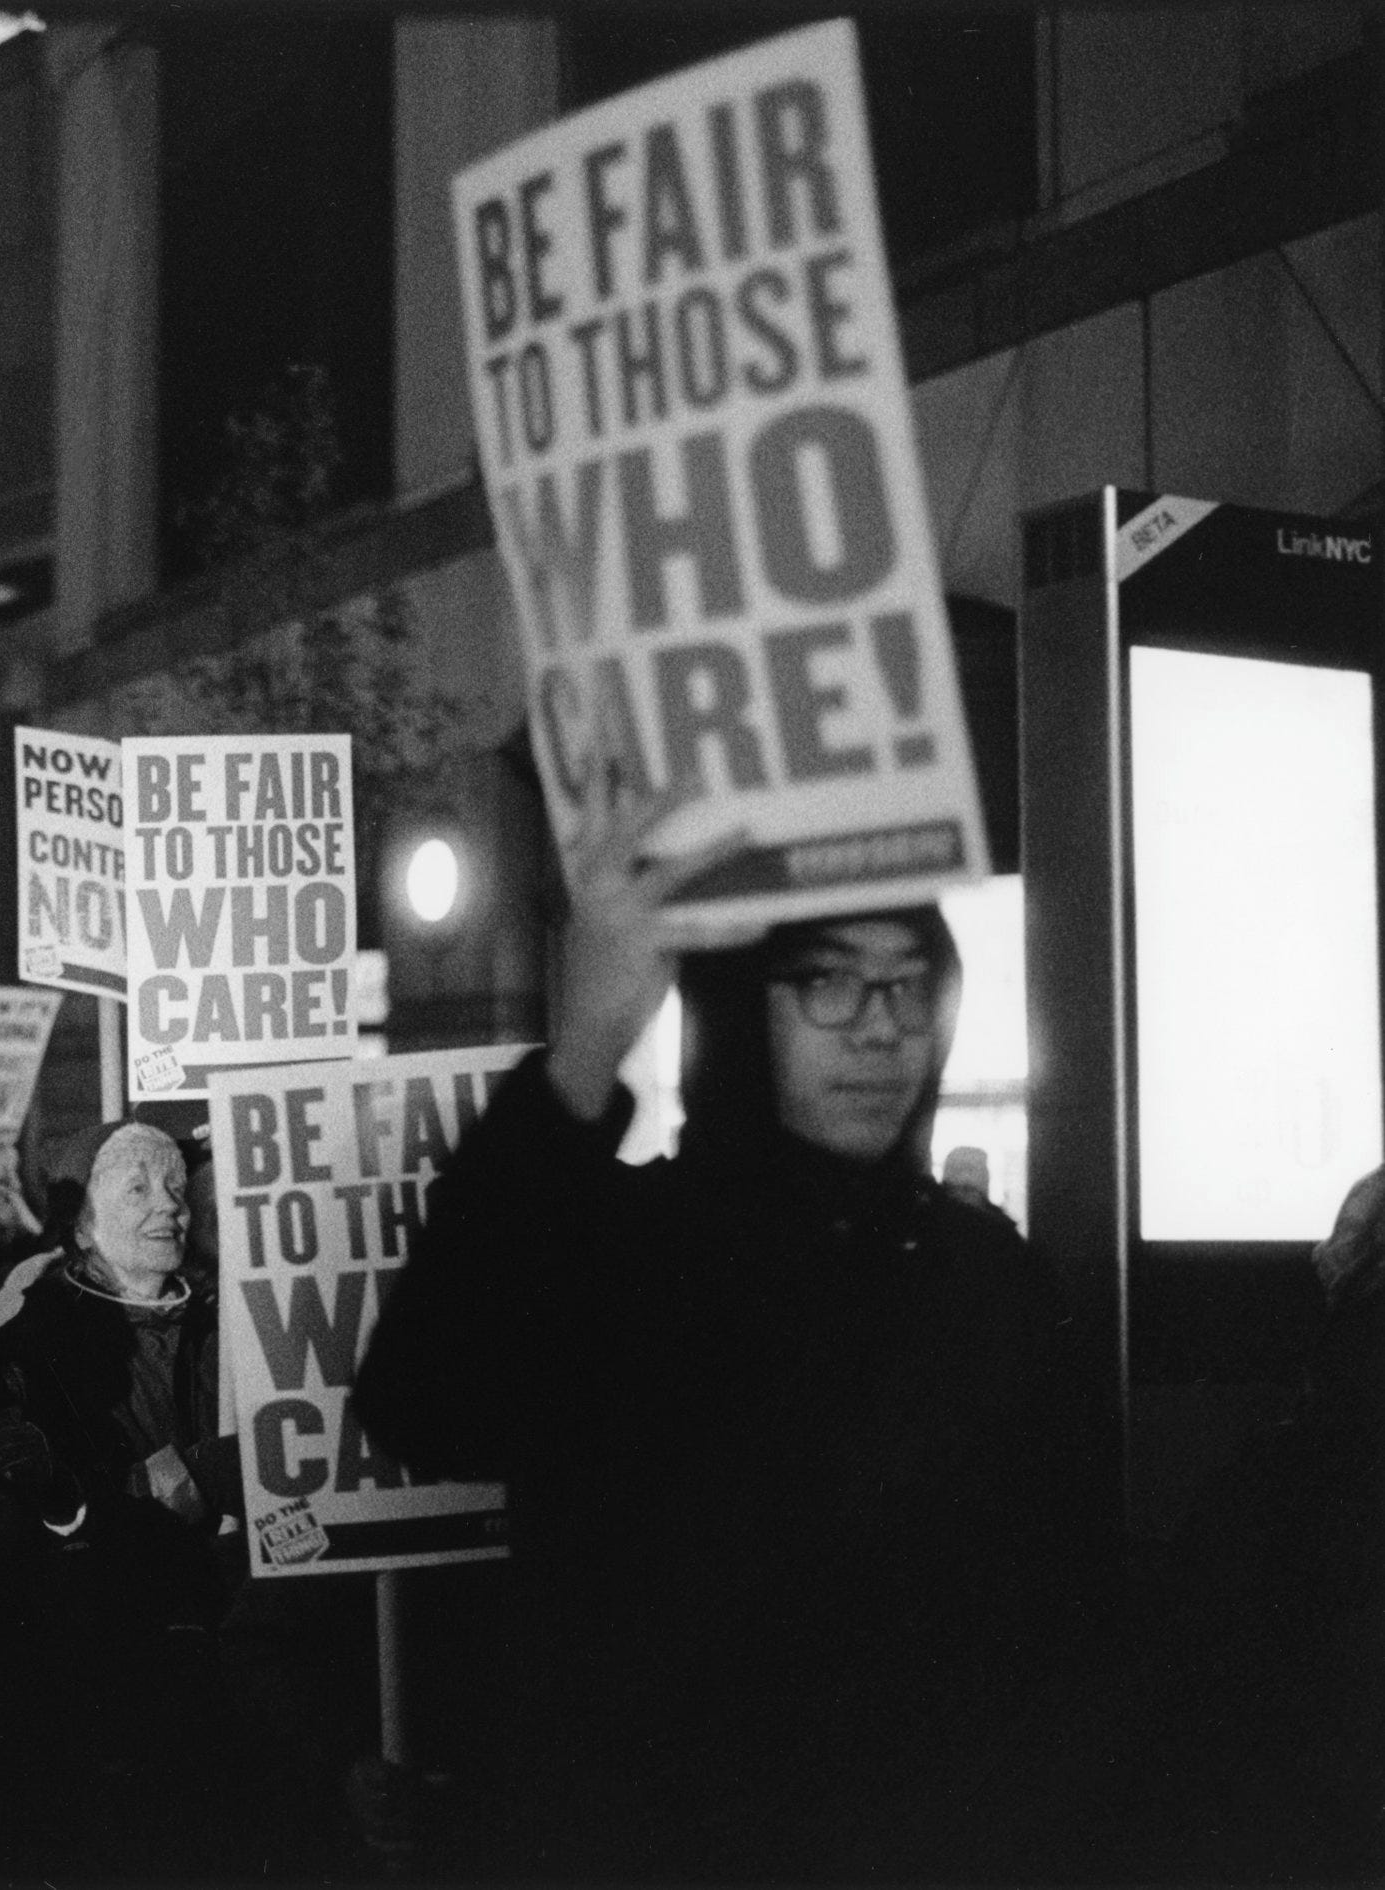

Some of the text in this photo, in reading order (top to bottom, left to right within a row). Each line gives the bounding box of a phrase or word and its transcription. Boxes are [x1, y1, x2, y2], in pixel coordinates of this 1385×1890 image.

[475, 78, 844, 347] BE FAIR
[485, 249, 868, 469] TO THOSE
[498, 404, 898, 654] WHO
[1131, 510, 1177, 552] BETA
[1276, 527, 1372, 565] LinkNYC
[539, 609, 939, 808] CARE!
[22, 743, 112, 781] NOW
[136, 751, 342, 824] BE FAIR
[134, 822, 346, 881] TO THOSE
[27, 870, 127, 959] NO
[135, 881, 347, 970] WHO
[137, 967, 349, 1046] CARE!
[134, 1044, 174, 1068] DO THE
[229, 1069, 508, 1189] BE FAI
[233, 1190, 320, 1269] TO
[255, 1497, 312, 1532] DO THE
